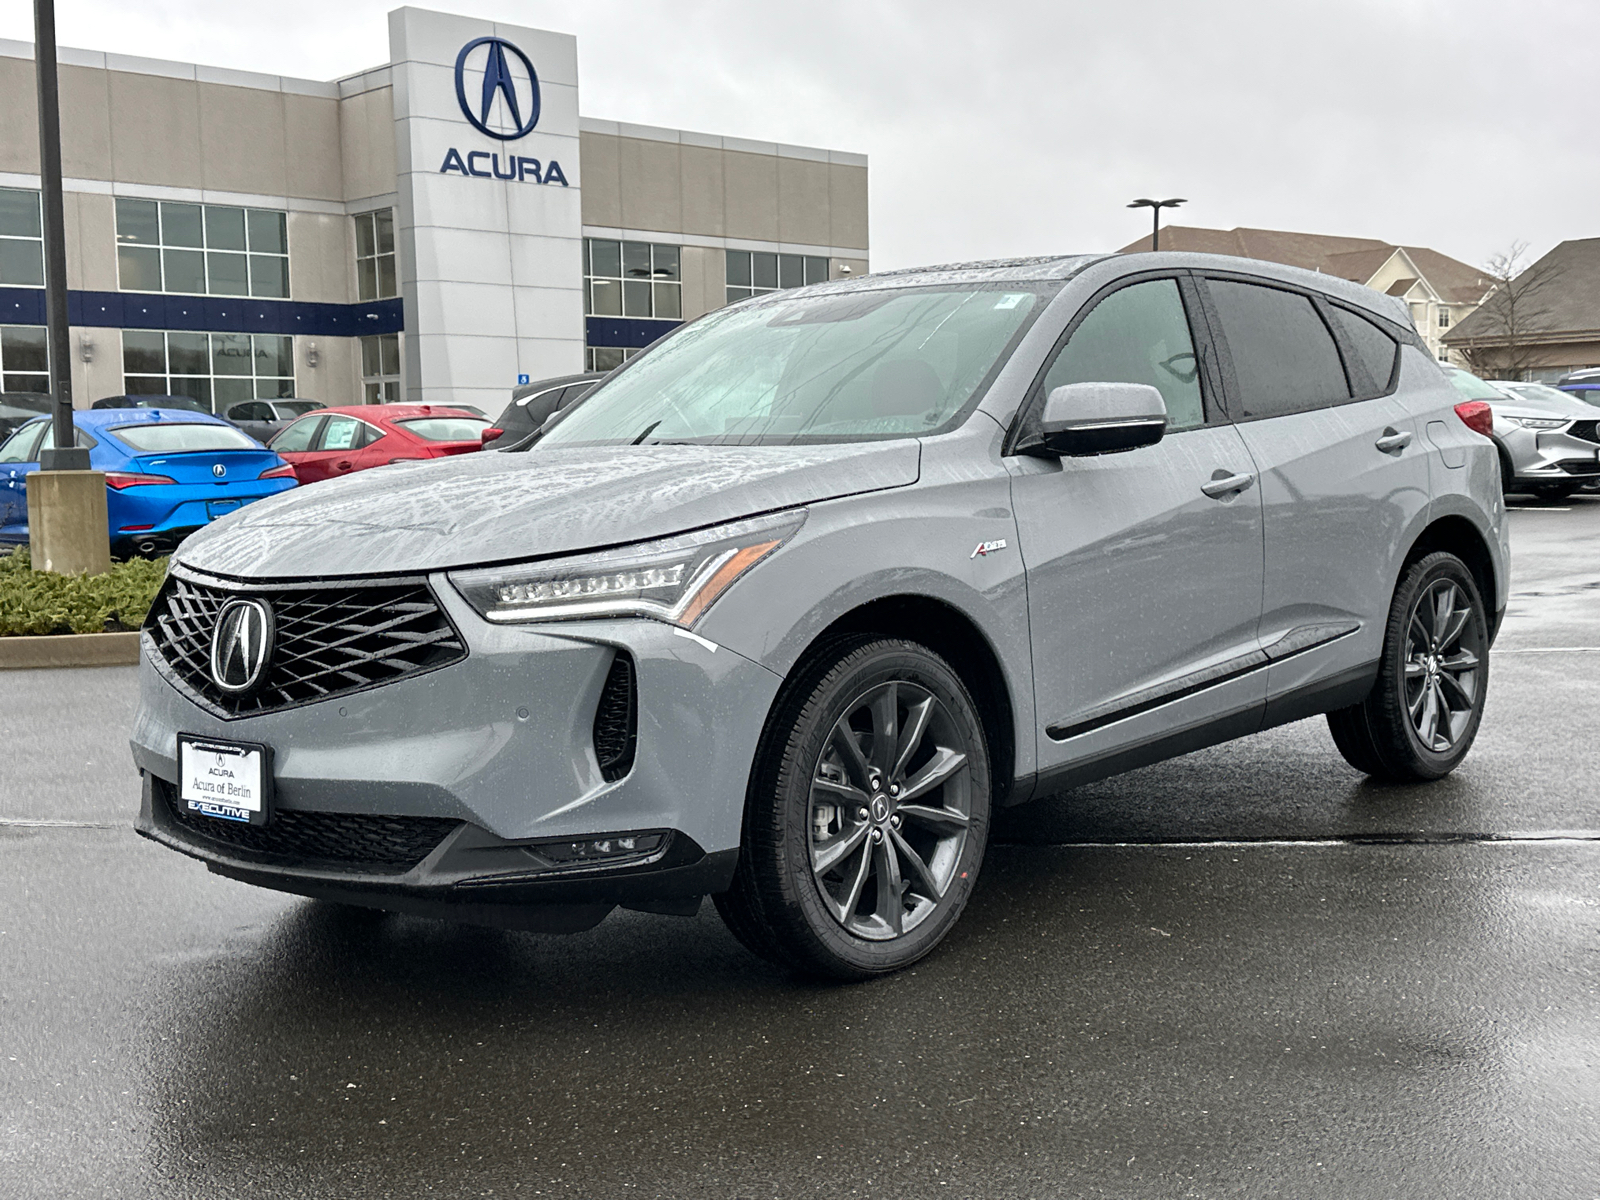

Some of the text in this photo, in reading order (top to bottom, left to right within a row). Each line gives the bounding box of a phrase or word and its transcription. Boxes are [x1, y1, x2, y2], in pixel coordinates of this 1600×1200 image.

[440, 147, 569, 187] ACURA
[208, 768, 235, 779] ACURA
[192, 777, 251, 799] Acura of Berlin
[188, 800, 250, 819] EXECUTIVE
